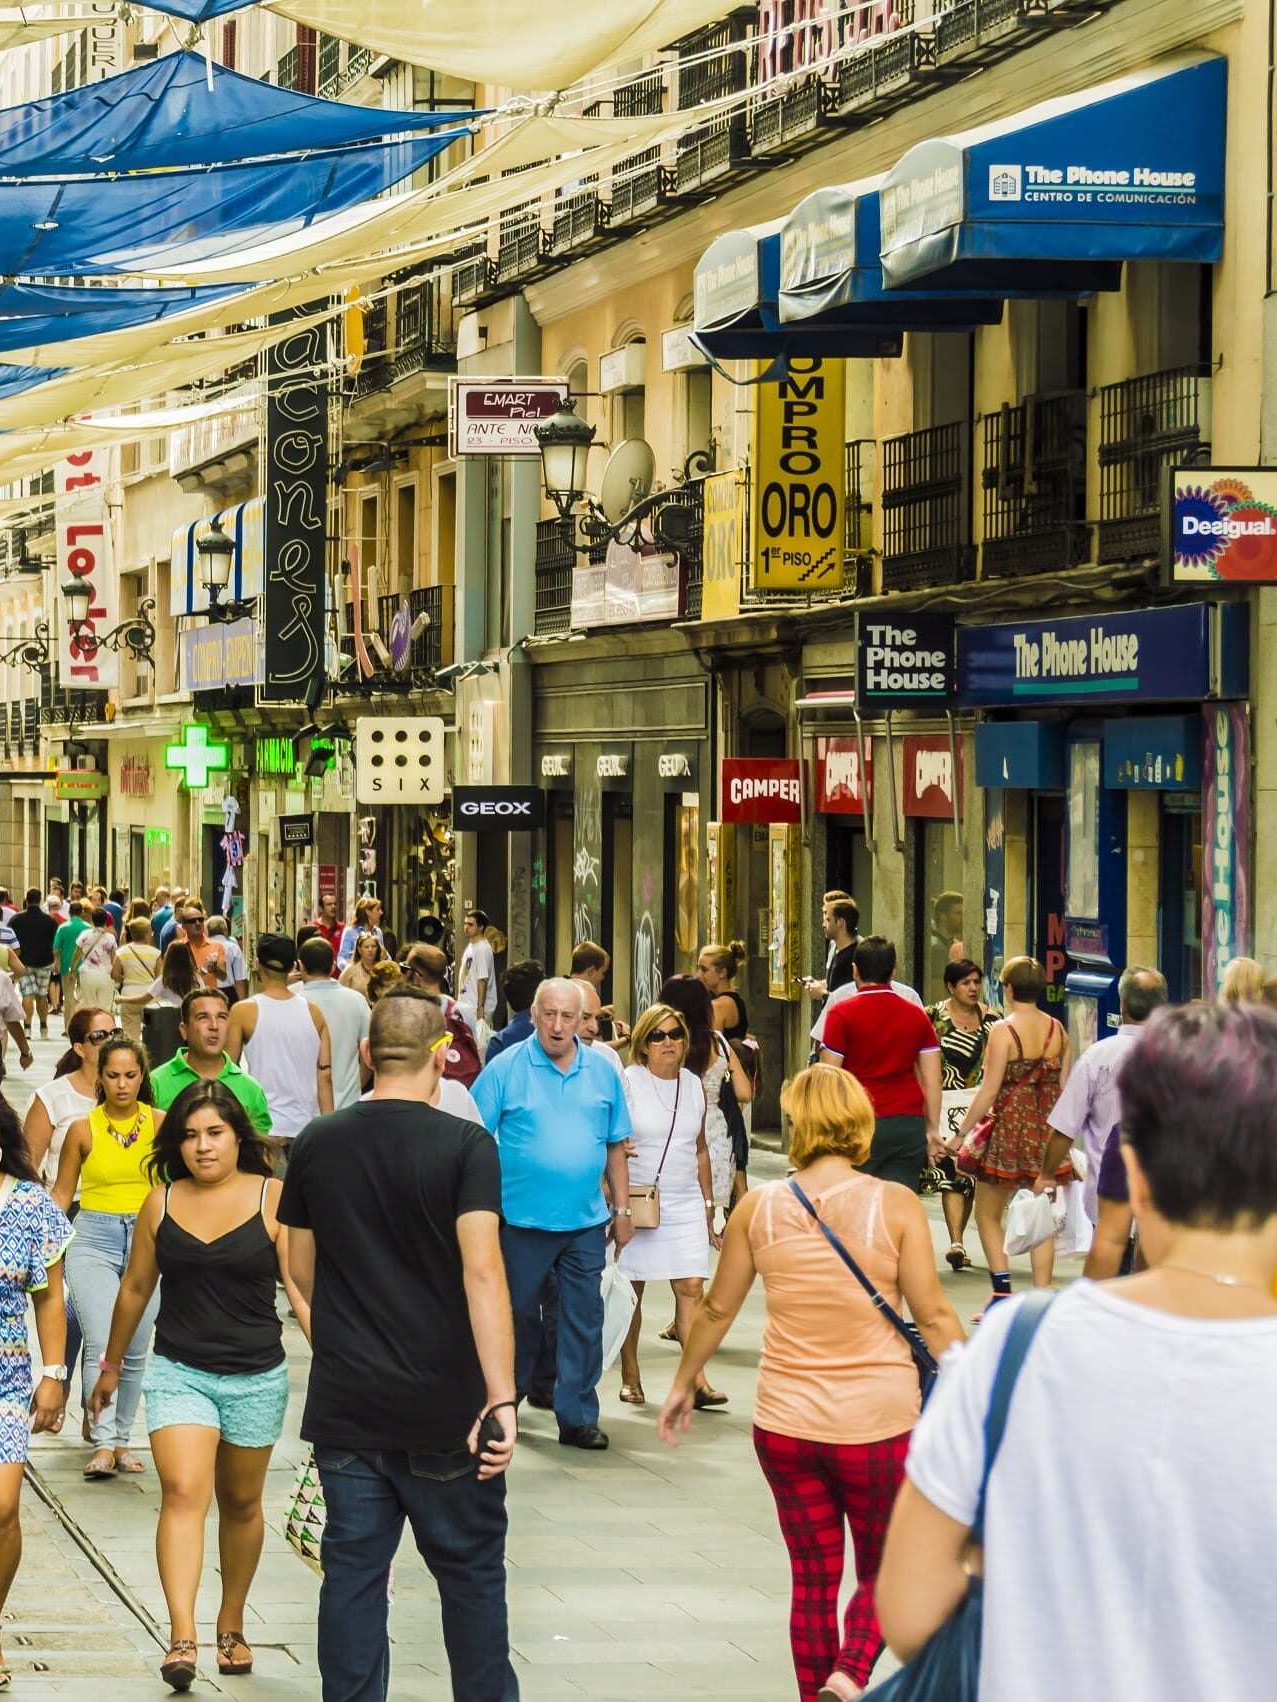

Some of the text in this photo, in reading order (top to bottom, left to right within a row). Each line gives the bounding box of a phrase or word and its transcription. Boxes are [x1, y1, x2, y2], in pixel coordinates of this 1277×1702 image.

[1026, 165, 1196, 186] The Phone House
[1024, 192, 1197, 205] CENTRO DE COMUNICACIÓN
[484, 392, 535, 406] EMART
[778, 357, 825, 476] OMPRO
[466, 423, 538, 435] ANTE NA
[499, 437, 534, 445] PISO
[761, 481, 837, 539] ORO
[782, 552, 812, 566] PISO
[65, 524, 108, 683] Loker
[866, 625, 917, 646] The
[866, 647, 946, 668] Phone
[1014, 627, 1139, 678] The Phone House
[866, 669, 946, 690] House
[730, 777, 801, 804] CAMPER
[460, 801, 532, 815] GEOX
[1214, 710, 1231, 900] House
